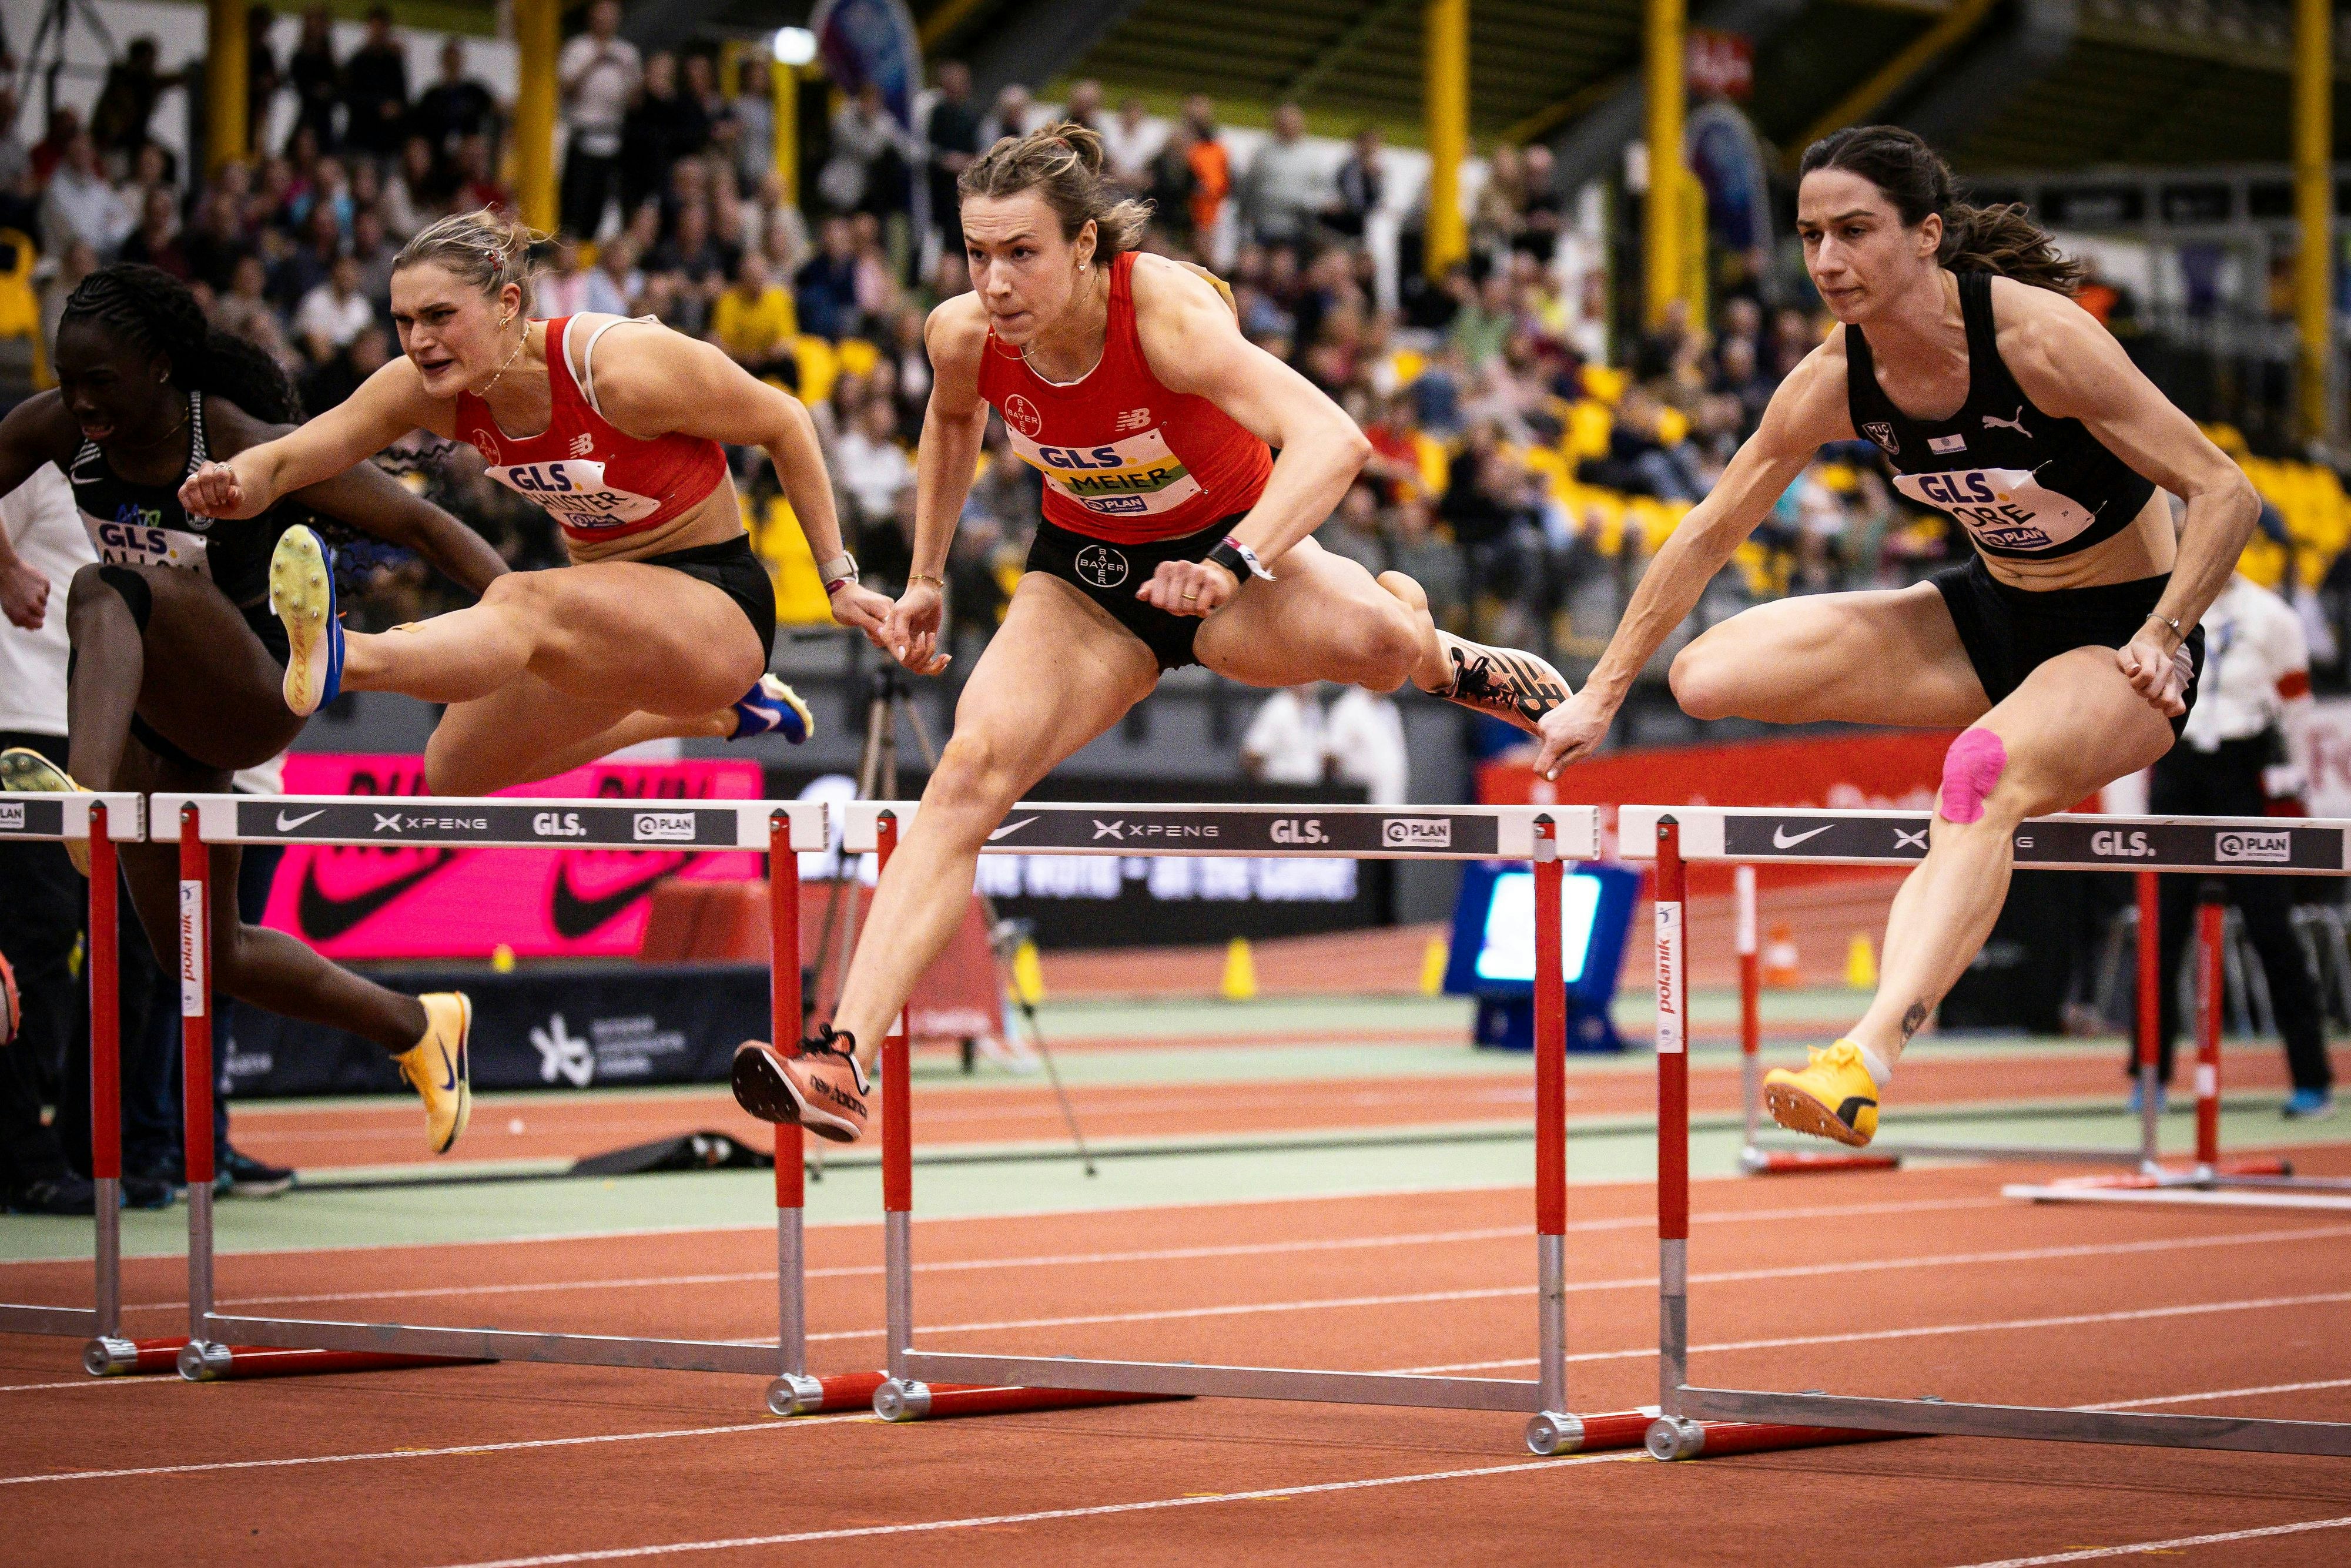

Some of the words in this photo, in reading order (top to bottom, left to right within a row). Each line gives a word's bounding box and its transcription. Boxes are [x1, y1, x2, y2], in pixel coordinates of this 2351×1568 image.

[1007, 408, 1039, 424] BAYER
[1069, 468, 1173, 491] MEIER
[1105, 499, 1142, 508] PLAN
[2003, 529, 2044, 543] PLAN
[1080, 559, 1125, 572] BAYER
[1097, 548, 1107, 585] BAYER
[0, 808, 22, 819] LAN
[406, 817, 488, 829] XPENG
[533, 813, 587, 836] GLS.
[659, 819, 692, 830] PLAN
[1129, 825, 1220, 837] XPENG
[1270, 819, 1329, 843] GLS.
[1411, 825, 1446, 837] PLAN
[2090, 830, 2157, 857] GLS.
[2247, 838, 2287, 851] PLAN
[1658, 940, 1676, 1014] polanik
